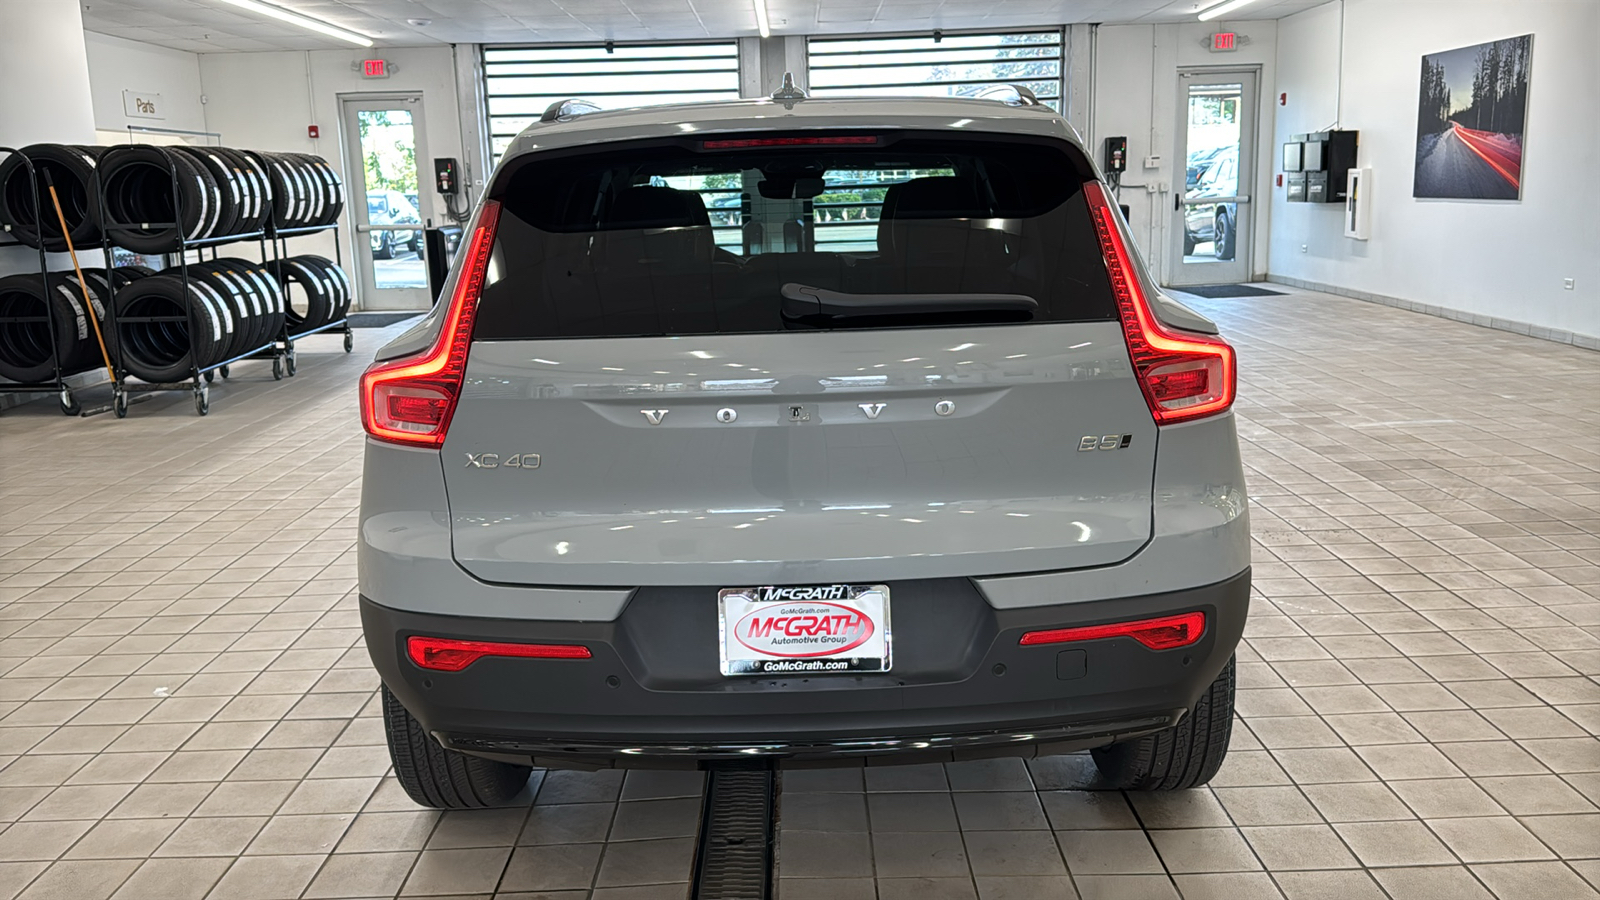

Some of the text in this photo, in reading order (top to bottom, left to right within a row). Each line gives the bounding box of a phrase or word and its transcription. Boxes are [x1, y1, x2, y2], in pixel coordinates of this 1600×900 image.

[1214, 33, 1235, 49] EXIT
[364, 59, 384, 76] EXIT
[136, 98, 156, 114] Parts
[1078, 434, 1120, 452] B5
[464, 452, 541, 469] XC 40
[780, 608, 830, 616] GoMcGrath.com
[771, 636, 847, 645] Automotive Group
[763, 661, 848, 672] GoMcGrath.com
